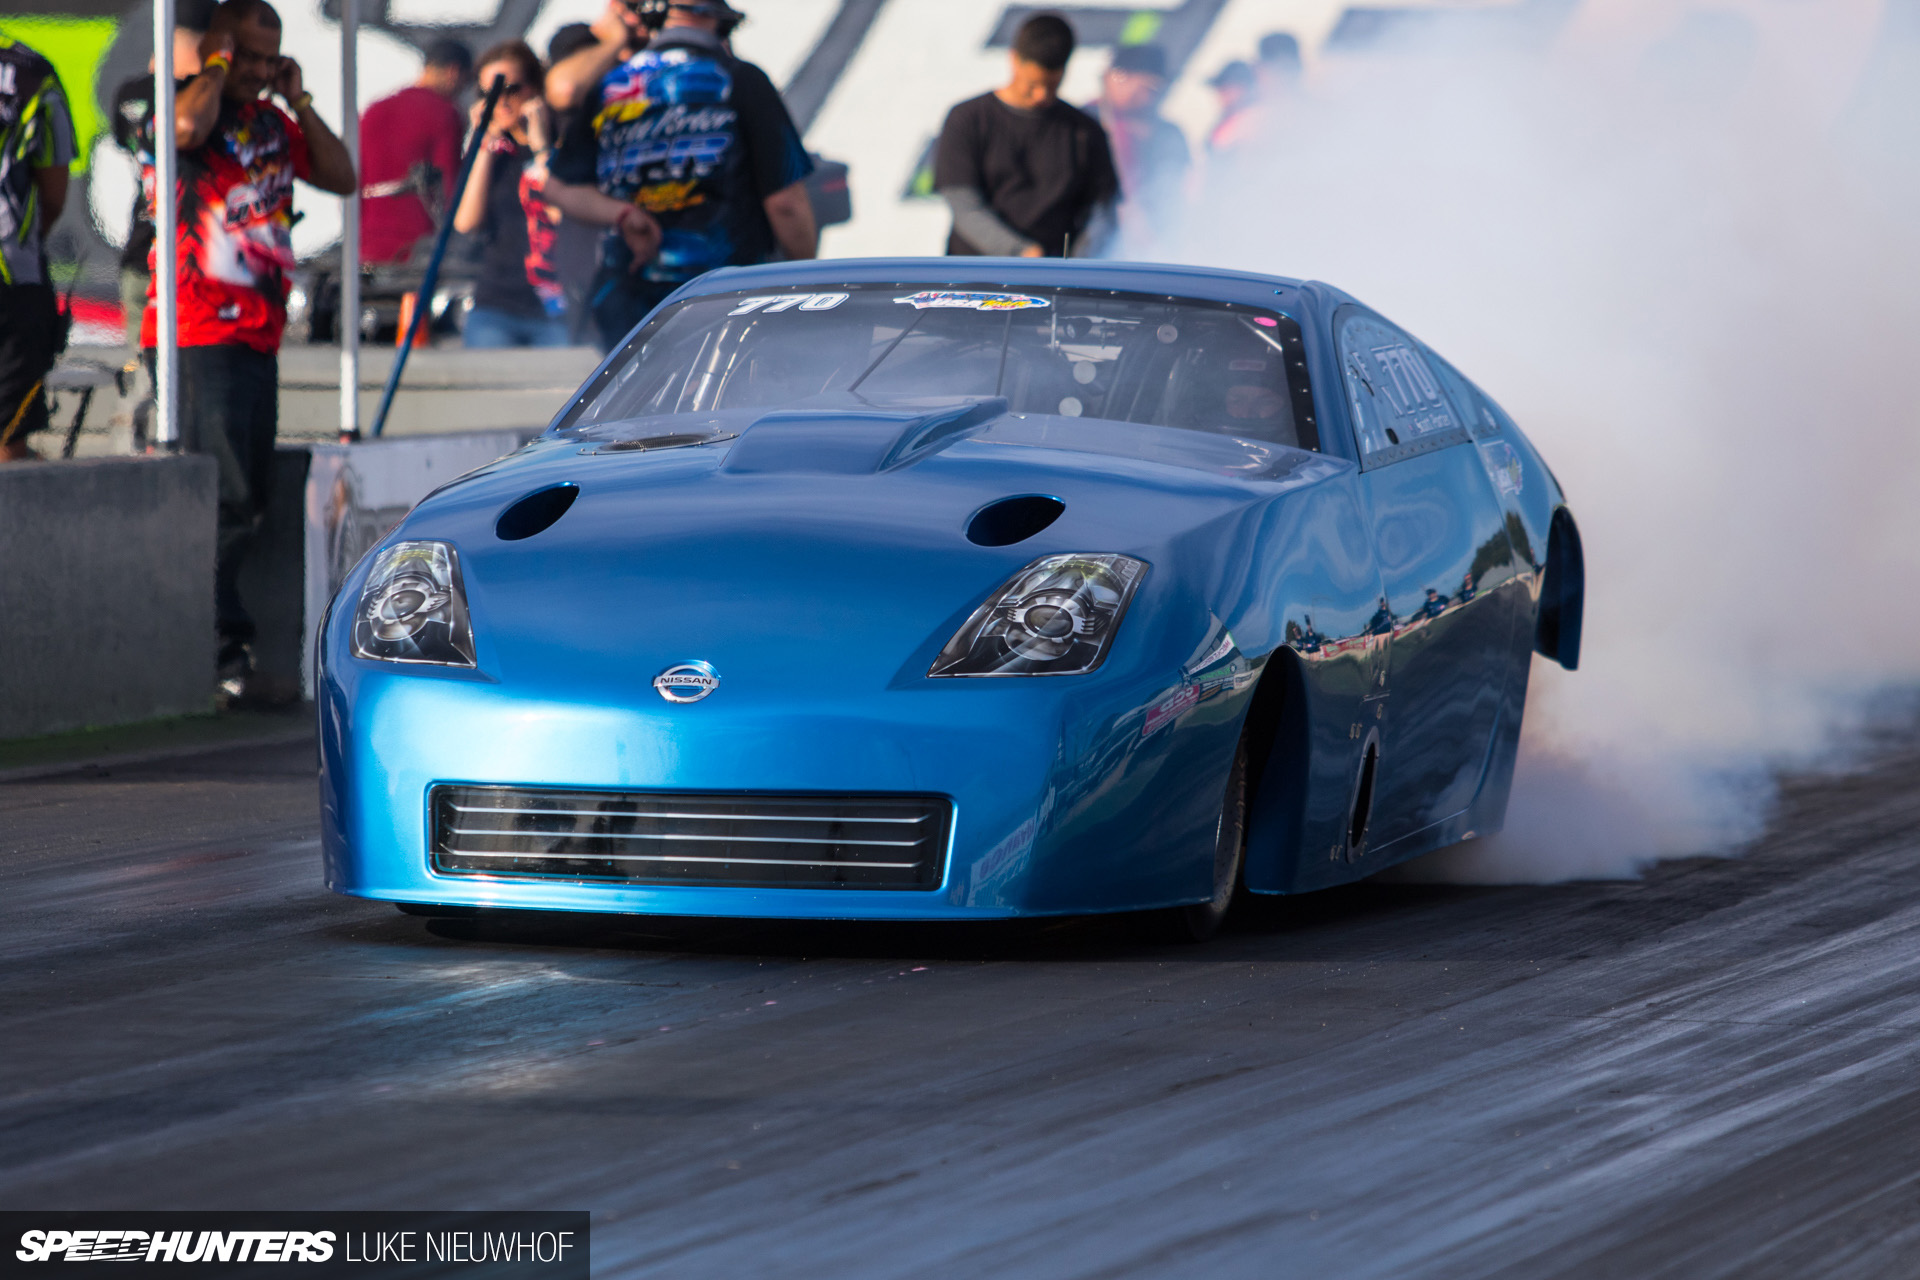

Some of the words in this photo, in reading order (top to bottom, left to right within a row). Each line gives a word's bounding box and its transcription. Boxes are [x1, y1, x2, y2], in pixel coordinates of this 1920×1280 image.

[728, 293, 849, 315] 770
[1371, 345, 1442, 413] 770
[660, 676, 712, 685] NISSAN
